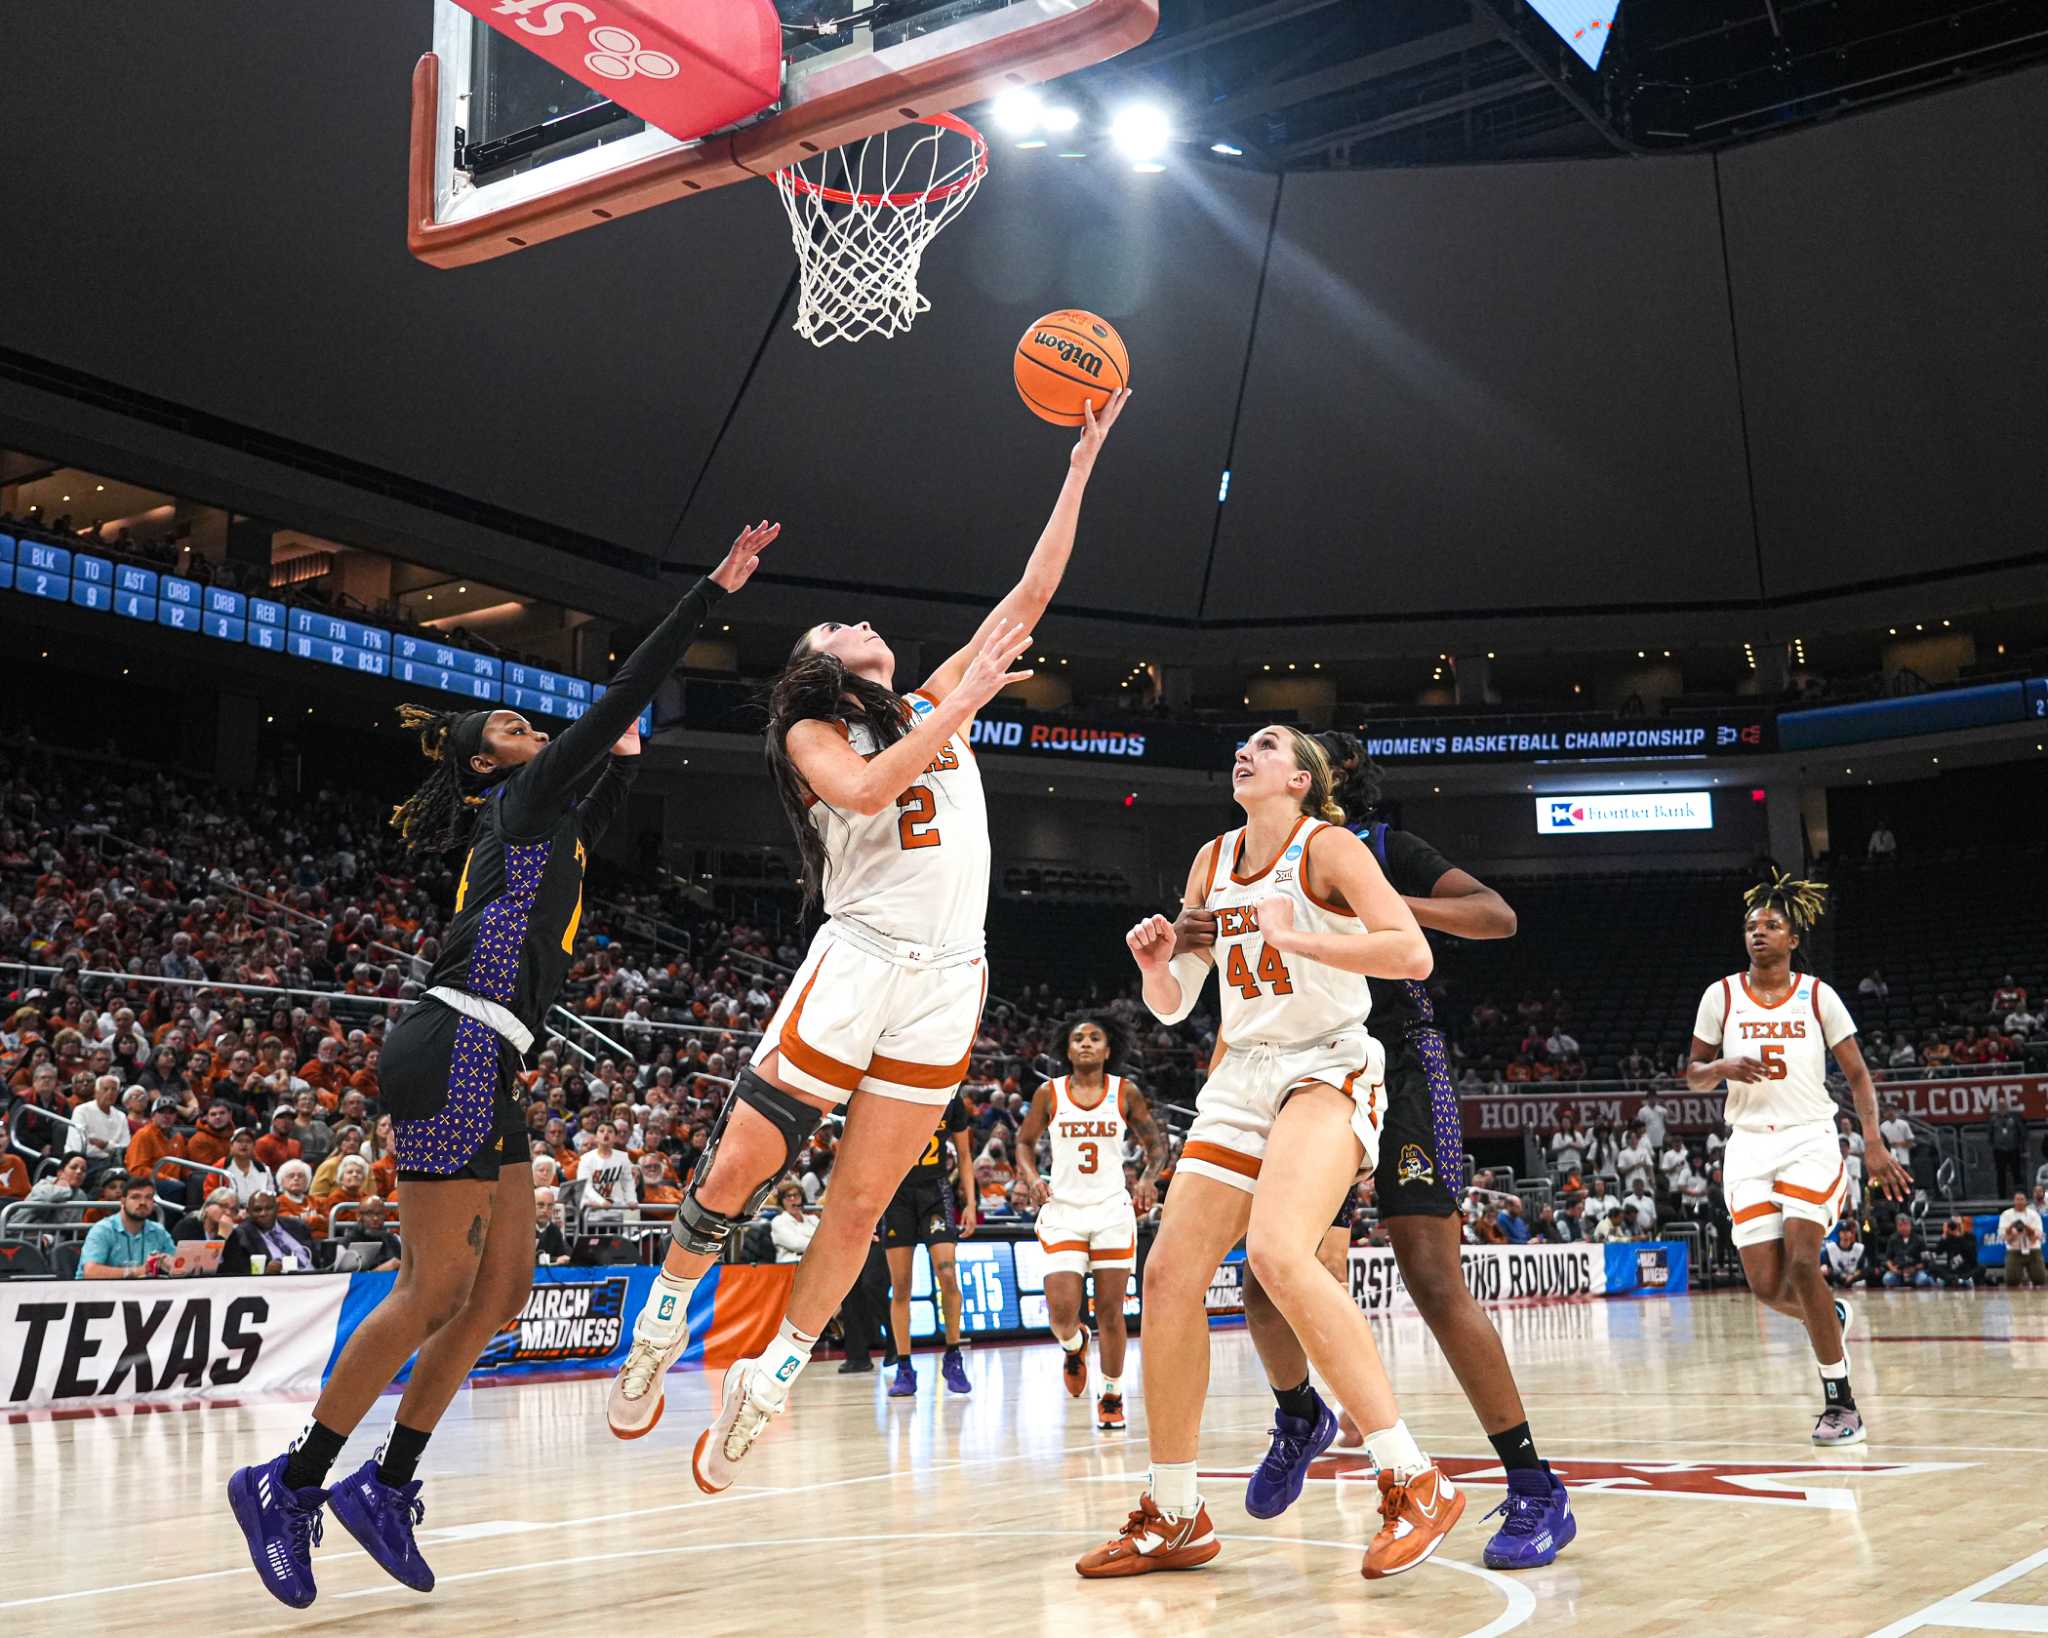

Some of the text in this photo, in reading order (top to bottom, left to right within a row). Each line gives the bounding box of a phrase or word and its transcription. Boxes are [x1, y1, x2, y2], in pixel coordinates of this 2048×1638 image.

[1034, 331, 1103, 378] Wilson
[32, 547, 55, 569] BLK
[85, 561, 99, 580] TO
[124, 571, 146, 591] AST
[256, 603, 276, 623] REB
[300, 614, 312, 632] FT
[330, 622, 346, 640] FTA
[403, 640, 416, 657] 3P
[437, 648, 454, 667] 3PA
[36, 575, 47, 595] 2
[86, 587, 97, 606] 9
[128, 597, 138, 616] 4
[171, 607, 185, 627] 12
[218, 618, 228, 637] 3
[259, 628, 272, 648] 15
[298, 638, 311, 657] 10
[331, 646, 344, 664] 12
[405, 663, 413, 681] 0
[441, 672, 449, 689] 2
[515, 689, 523, 706] 7
[970, 720, 1146, 756] OND ROUNDS
[1367, 728, 1705, 755] WOMEN'S BASKETBALL CHAMPIONSHIP
[896, 785, 941, 850] 2
[1588, 803, 1696, 820] Frontier Bank
[1227, 944, 1294, 1000] 44
[1739, 1020, 1806, 1039] TEXAS
[1760, 1045, 1787, 1080] 5
[1480, 1102, 1560, 1128] HOOK
[1662, 1098, 1725, 1124] ORN
[1878, 1084, 2025, 1116] ELCOME
[1058, 1121, 1117, 1138] TEXAS
[1078, 1142, 1098, 1174] 3
[1346, 1257, 1395, 1309] RST
[1460, 1254, 1501, 1300] OND
[1509, 1252, 1591, 1300] ROUNDS
[10, 1296, 270, 1401] TEXAS
[520, 1318, 620, 1350] MADNESS
